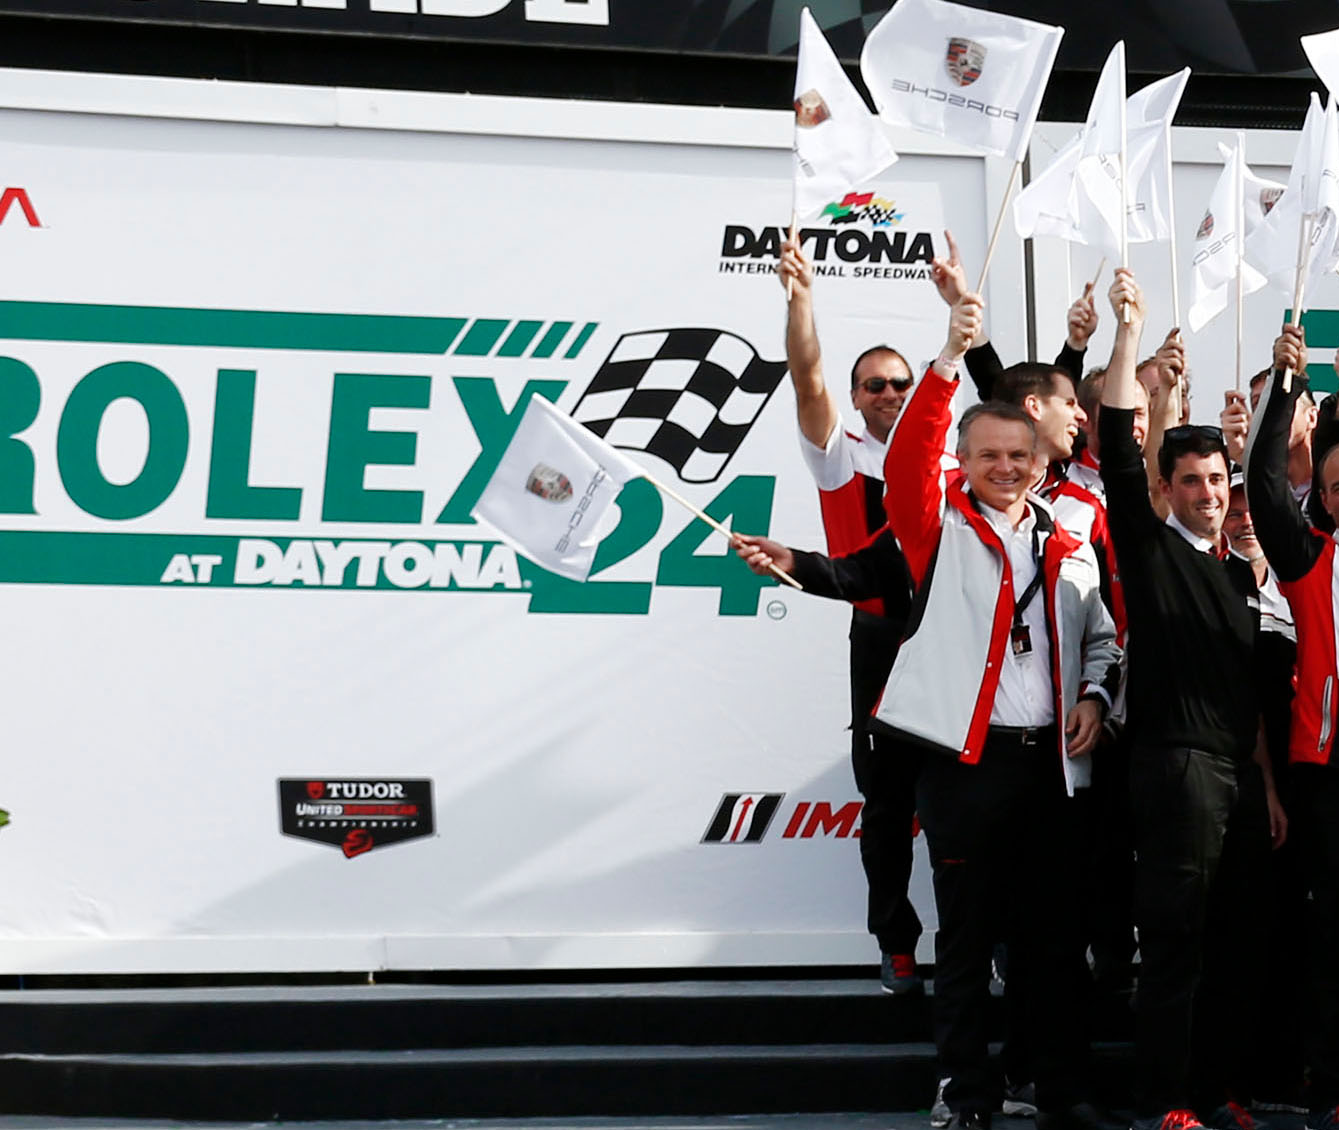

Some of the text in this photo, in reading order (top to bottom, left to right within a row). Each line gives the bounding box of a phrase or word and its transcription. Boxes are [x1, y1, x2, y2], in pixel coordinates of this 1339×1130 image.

[722, 225, 935, 265] DAYTONA
[719, 262, 846, 278] INTERNNAL
[527, 474, 778, 617] 24
[161, 540, 522, 589] AT DAYTONA
[327, 783, 405, 800] TUDOR
[296, 803, 343, 817] UNITED
